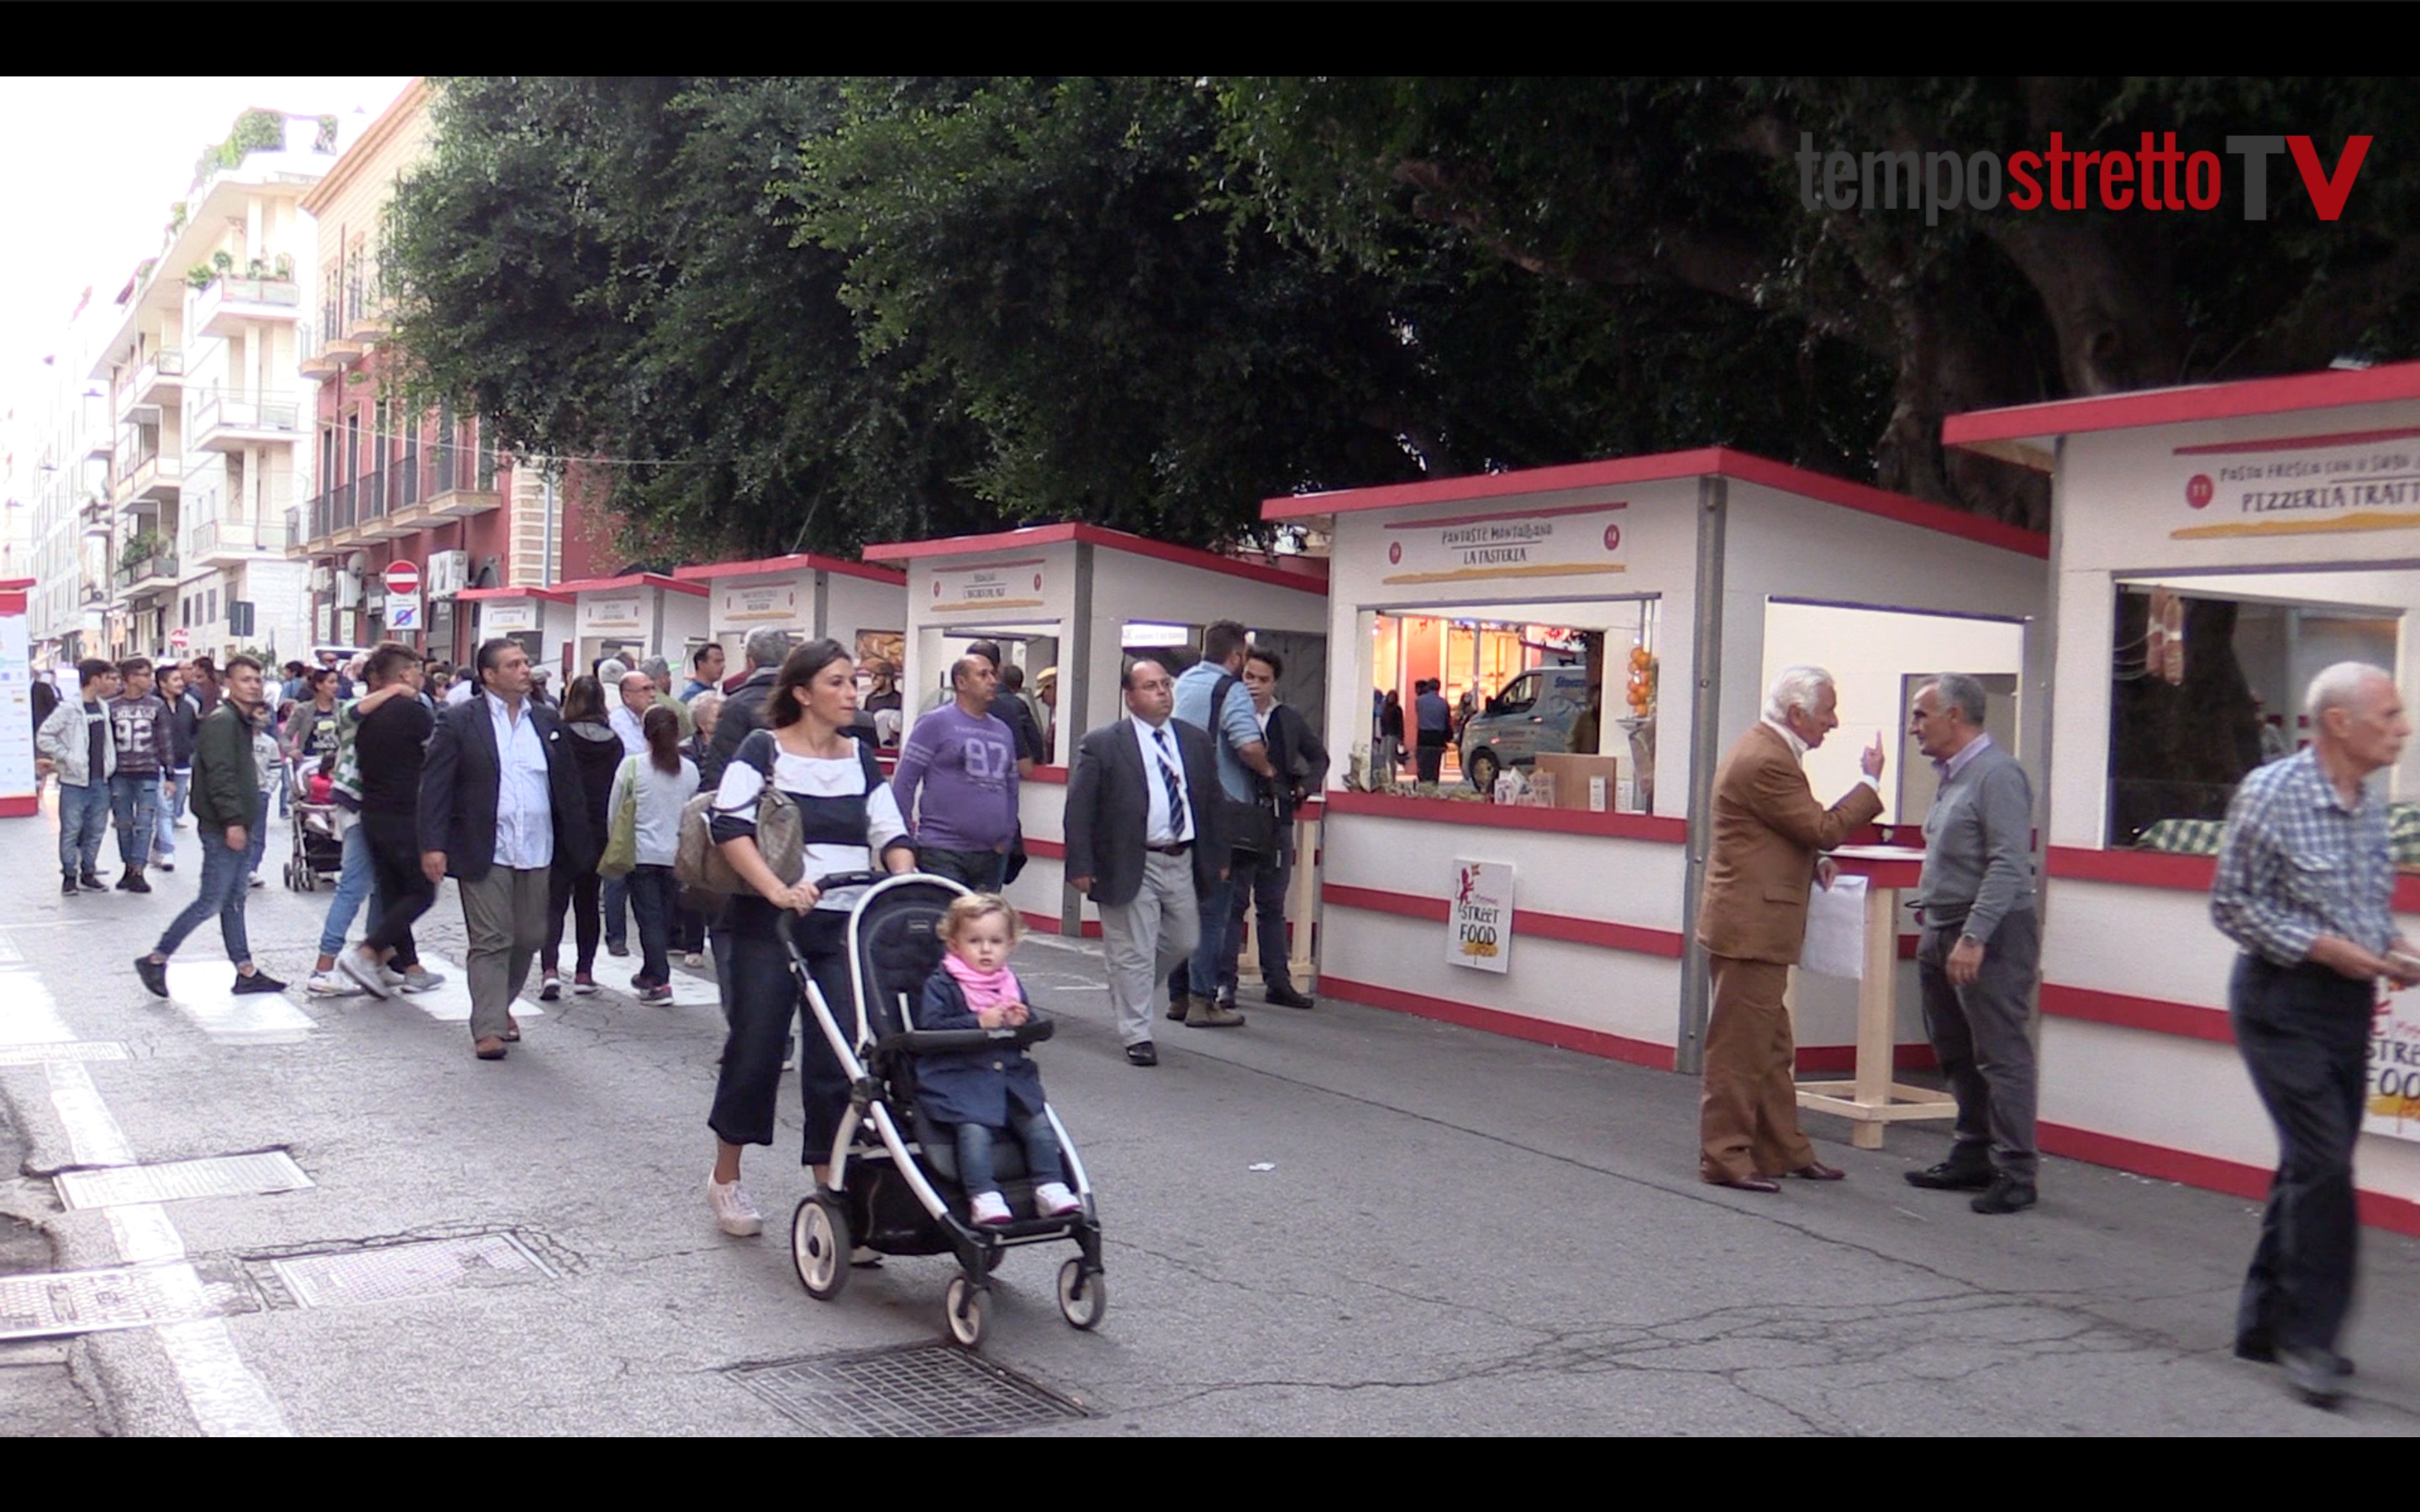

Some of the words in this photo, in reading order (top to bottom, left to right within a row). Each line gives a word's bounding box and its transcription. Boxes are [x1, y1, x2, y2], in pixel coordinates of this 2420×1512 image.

[2242, 486, 2345, 512] PIZZERIA
[115, 718, 153, 752] 92
[1460, 923, 1497, 946] FOOD
